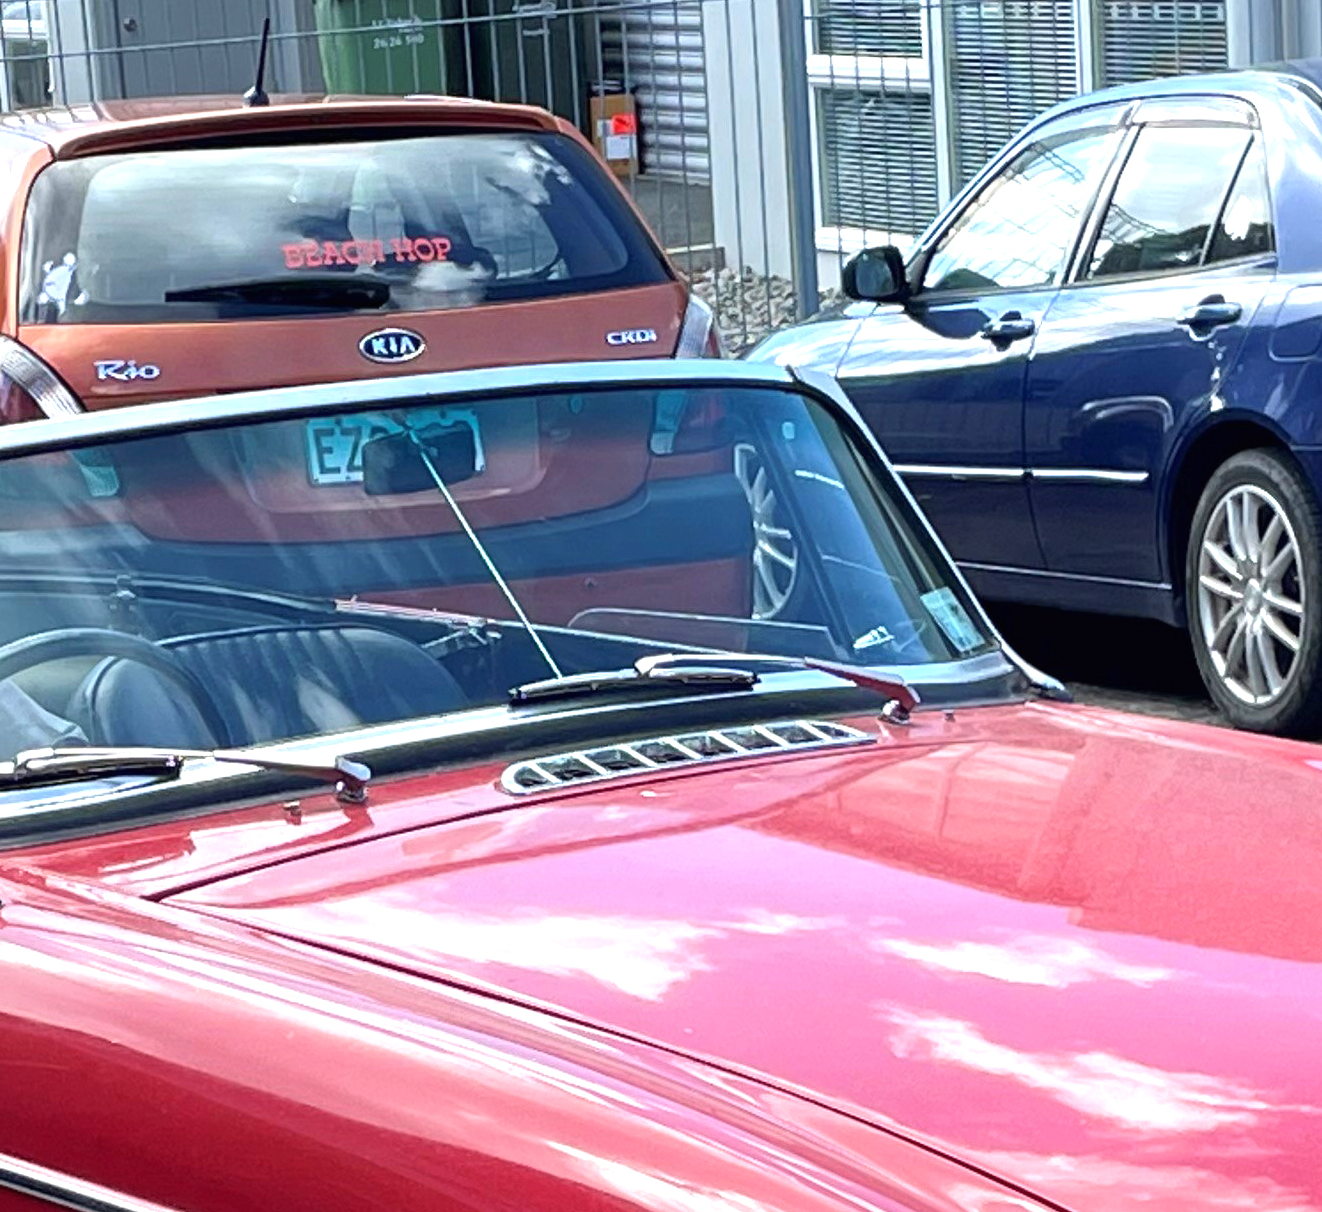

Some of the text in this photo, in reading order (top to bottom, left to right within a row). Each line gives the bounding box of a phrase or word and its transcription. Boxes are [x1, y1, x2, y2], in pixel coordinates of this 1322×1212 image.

[282, 236, 451, 269] BEACH HOP
[371, 335, 416, 355] KIA
[93, 359, 161, 381] Rio
